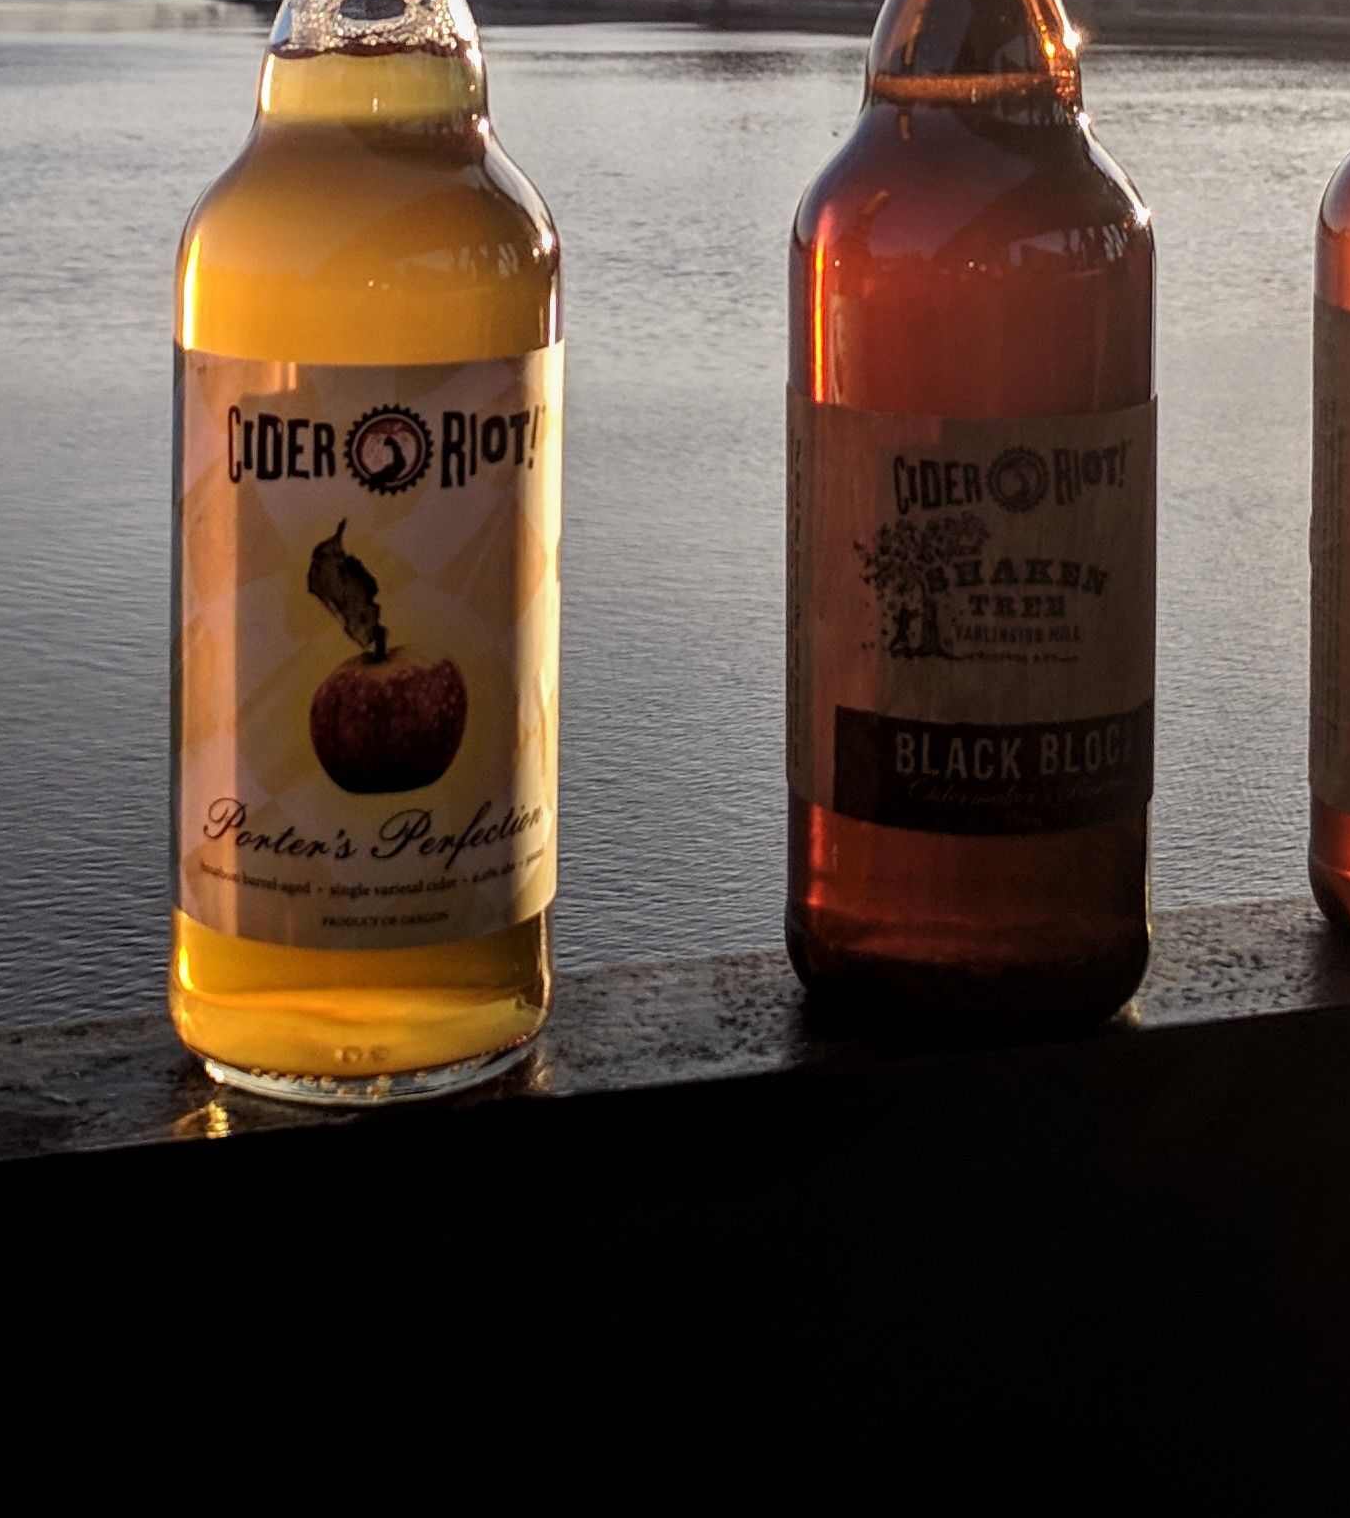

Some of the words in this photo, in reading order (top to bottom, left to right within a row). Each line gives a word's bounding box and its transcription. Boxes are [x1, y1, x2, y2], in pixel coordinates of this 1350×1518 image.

[227, 404, 337, 483] CIDER
[440, 405, 539, 489] RIOT!
[893, 454, 983, 515] CIDER
[1052, 439, 1127, 506] RIOT!
[968, 593, 1066, 619] TREE
[894, 730, 1024, 781] BLACK
[203, 797, 359, 860] Porter's
[371, 800, 545, 869] Perfection
